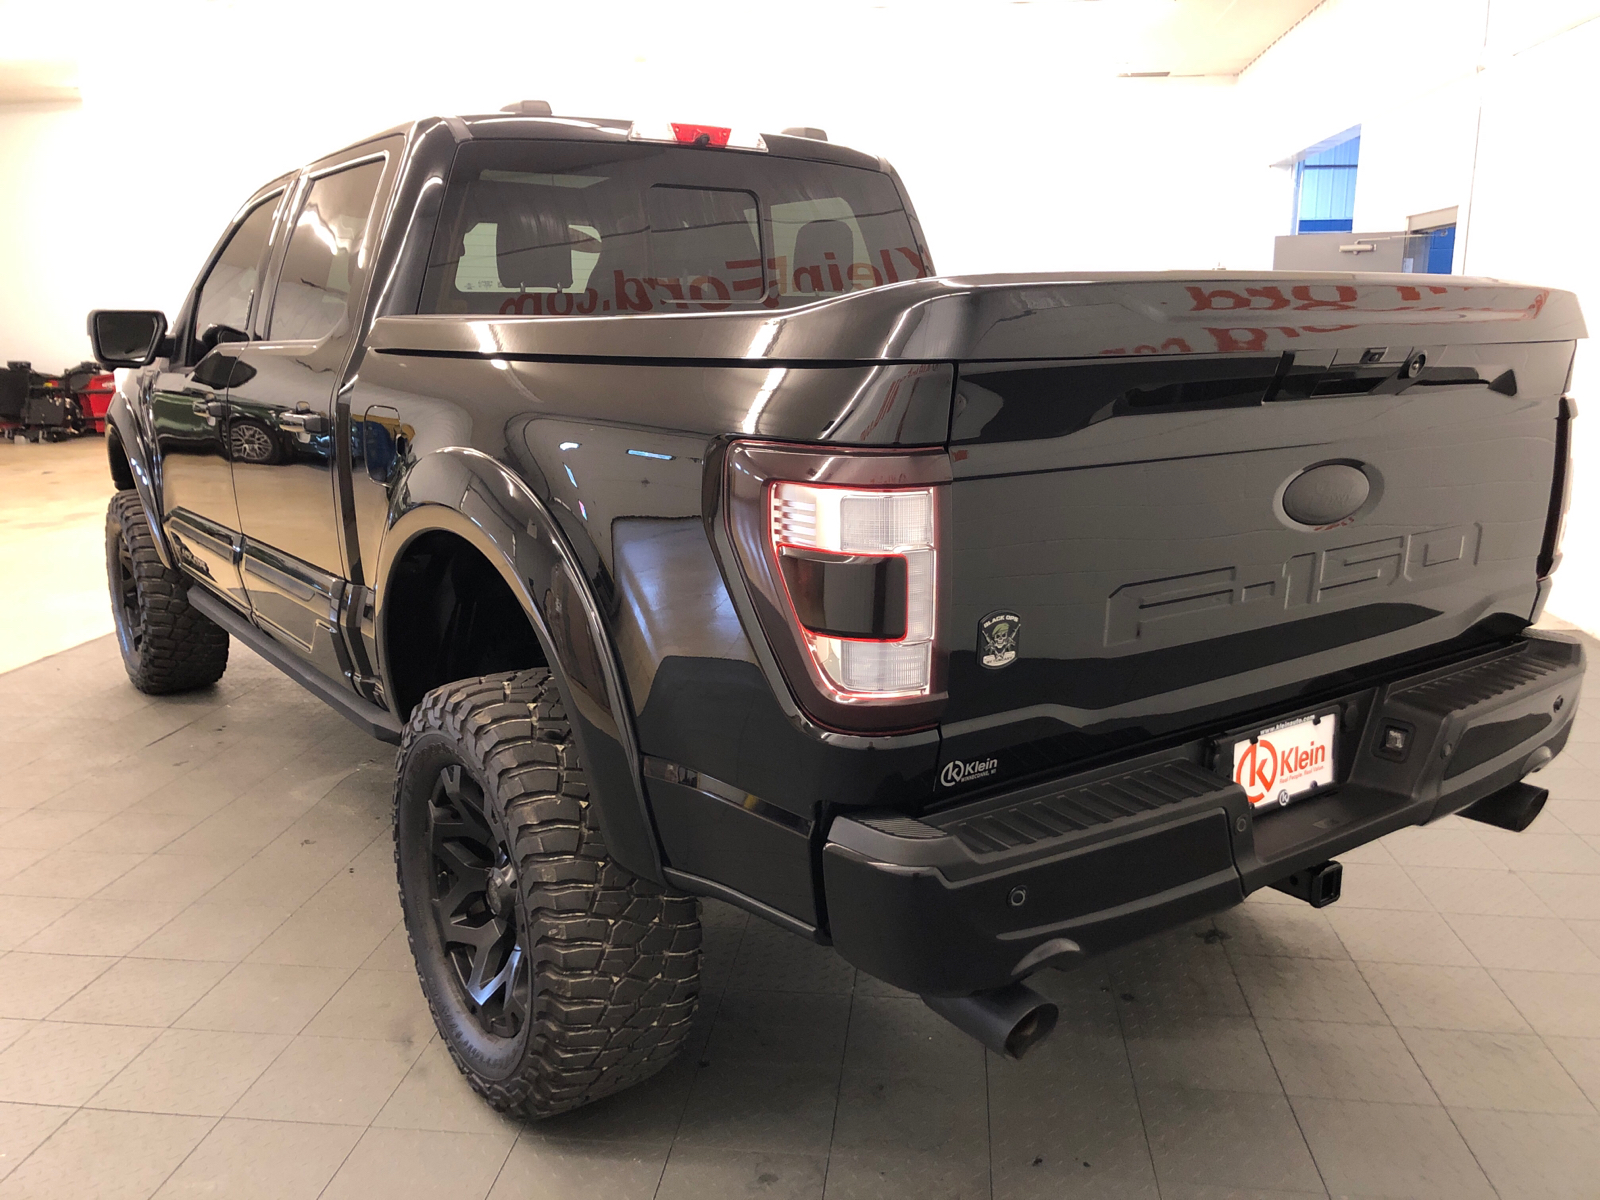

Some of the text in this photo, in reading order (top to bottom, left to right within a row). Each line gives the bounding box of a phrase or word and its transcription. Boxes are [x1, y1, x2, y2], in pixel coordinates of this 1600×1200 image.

[1102, 521, 1483, 648] F-150
[983, 614, 1019, 628] BLACK OPS
[964, 757, 998, 776] Klein
[1279, 740, 1326, 777] Klein
